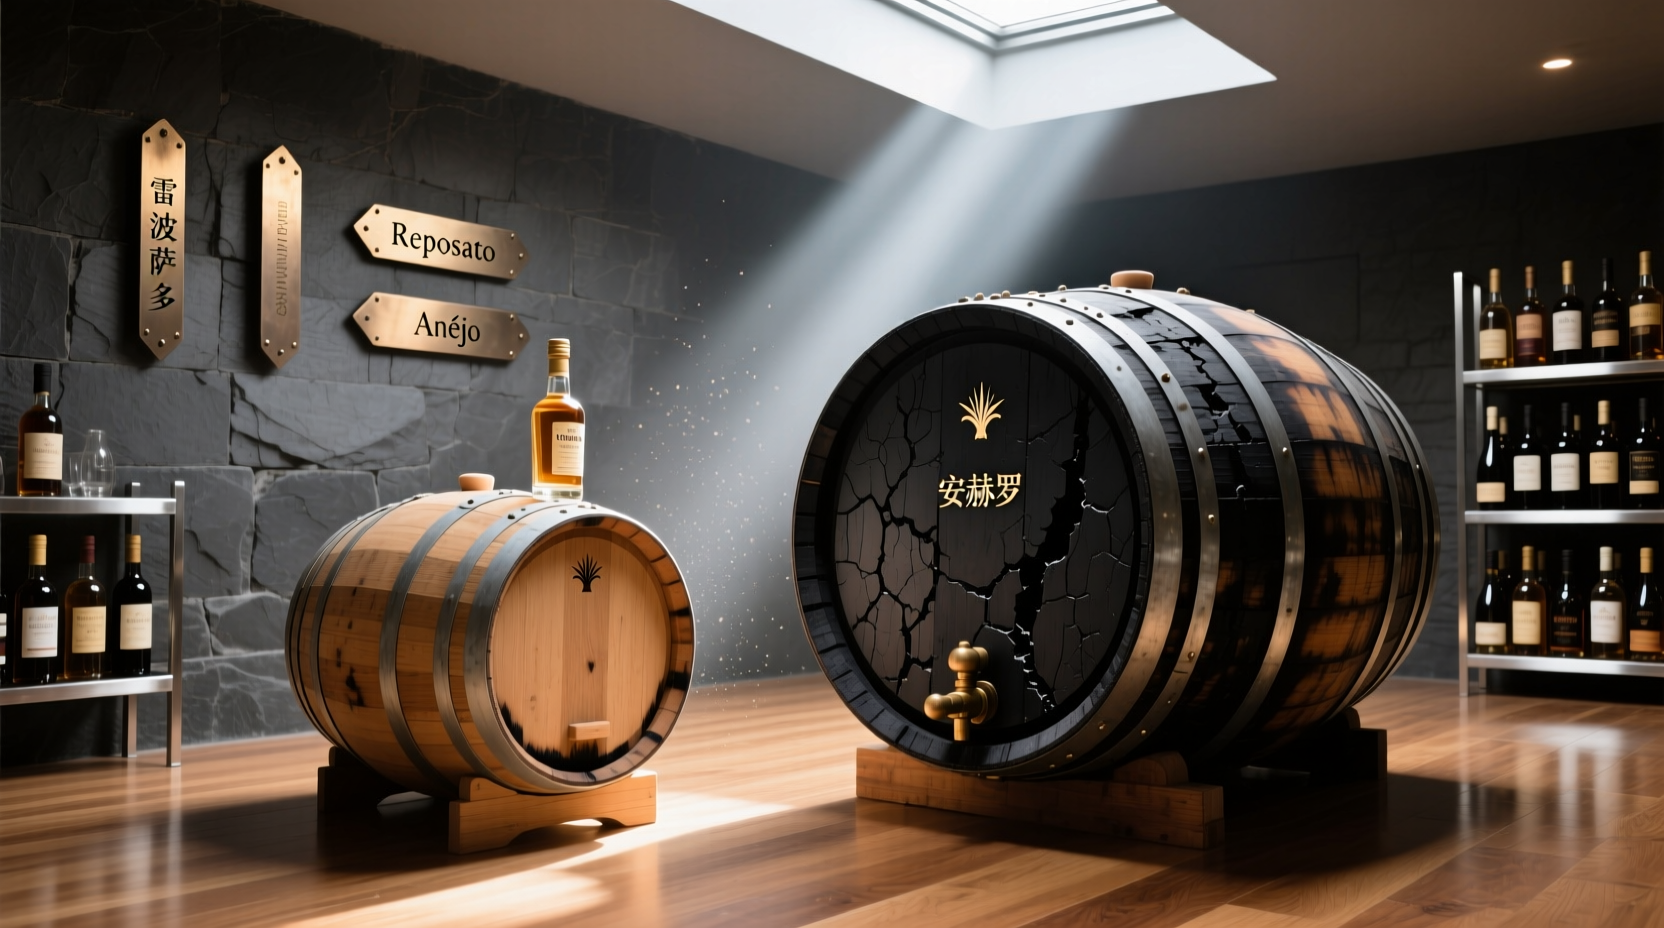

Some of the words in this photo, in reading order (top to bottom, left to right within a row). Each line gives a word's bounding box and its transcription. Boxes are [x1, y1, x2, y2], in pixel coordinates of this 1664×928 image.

[149, 177, 178, 311] 雷波萨多
[391, 222, 496, 262] Reposato
[414, 311, 481, 347] Anéjo
[938, 473, 1022, 508] 安赫罗
